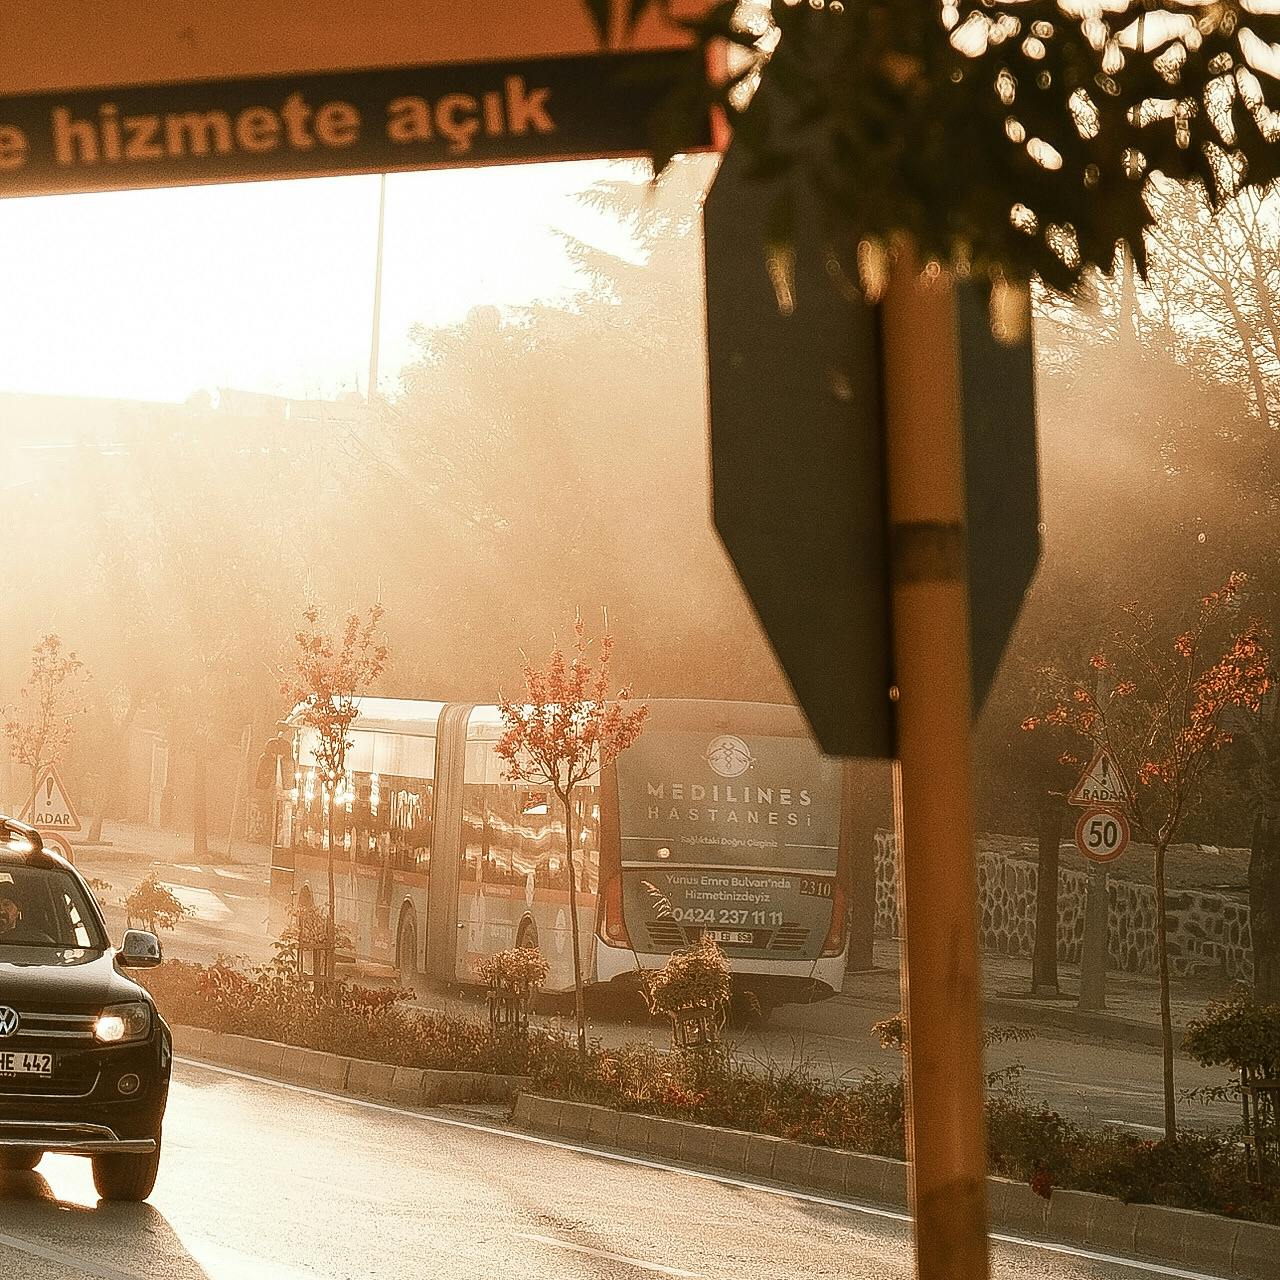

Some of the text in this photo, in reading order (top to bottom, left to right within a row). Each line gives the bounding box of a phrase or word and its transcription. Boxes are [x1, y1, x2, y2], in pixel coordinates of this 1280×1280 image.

[51, 91, 360, 166] hizmete
[385, 73, 556, 155] açık
[647, 782, 812, 806] MEDILINES
[1089, 821, 1117, 848] 50
[665, 874, 699, 885] Yunus
[701, 876, 729, 886] Emre
[801, 880, 831, 897] 2310
[685, 889, 771, 904] Hizmetinizdeyiz
[673, 907, 715, 922] 0424
[719, 909, 749, 924] 237
[23, 1054, 51, 1072] 442
